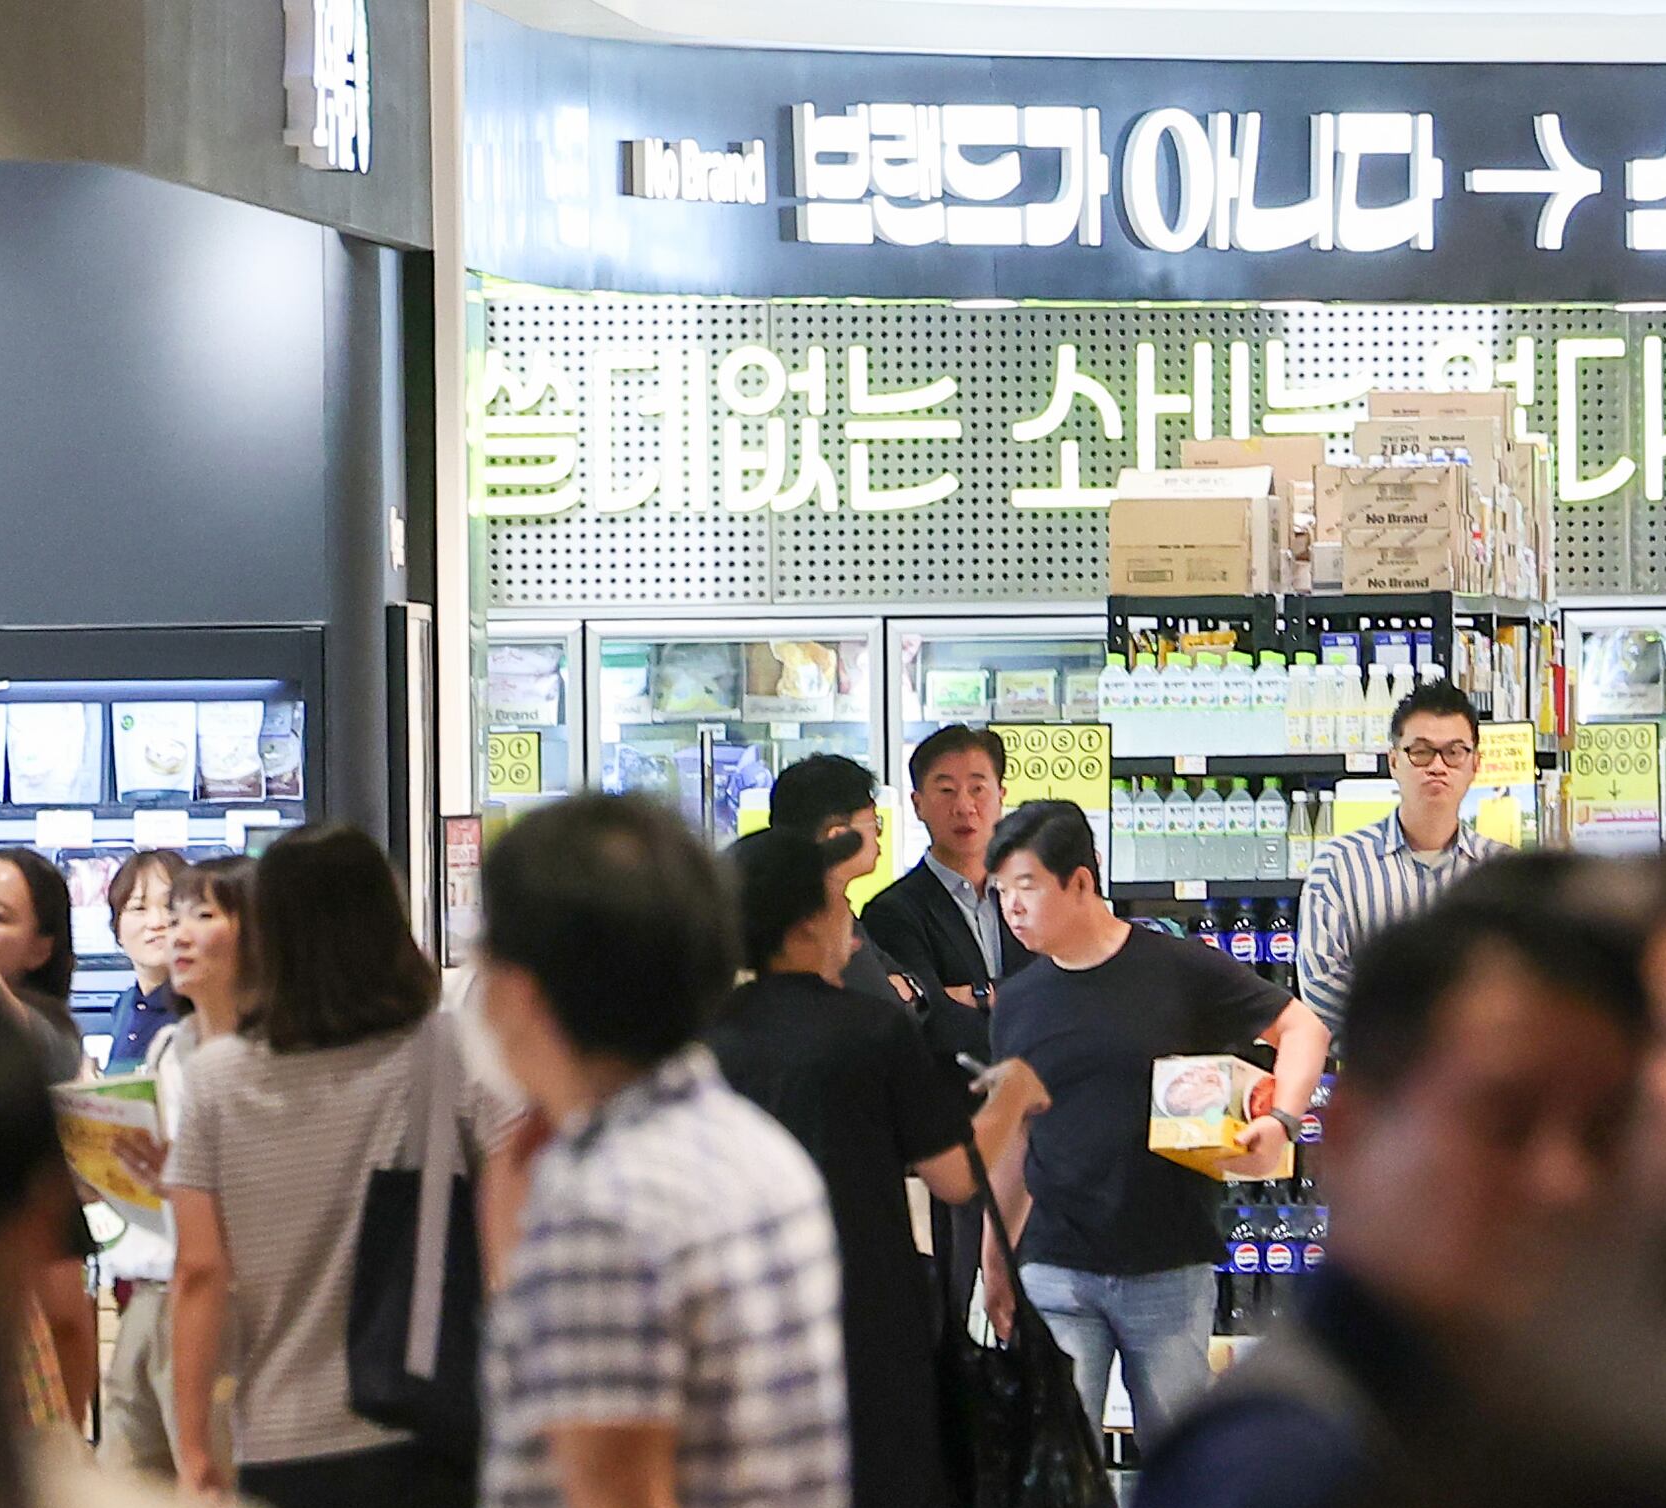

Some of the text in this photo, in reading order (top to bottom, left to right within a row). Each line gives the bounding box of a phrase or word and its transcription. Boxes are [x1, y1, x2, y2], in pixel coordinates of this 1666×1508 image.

[639, 137, 766, 204] No Brand
[793, 103, 1444, 253] 브랜드가 아니다
[481, 345, 963, 516] 쓸데없는
[1366, 513, 1429, 524] No Brand
[1367, 578, 1430, 589] No Brand
[494, 708, 539, 721] Brand
